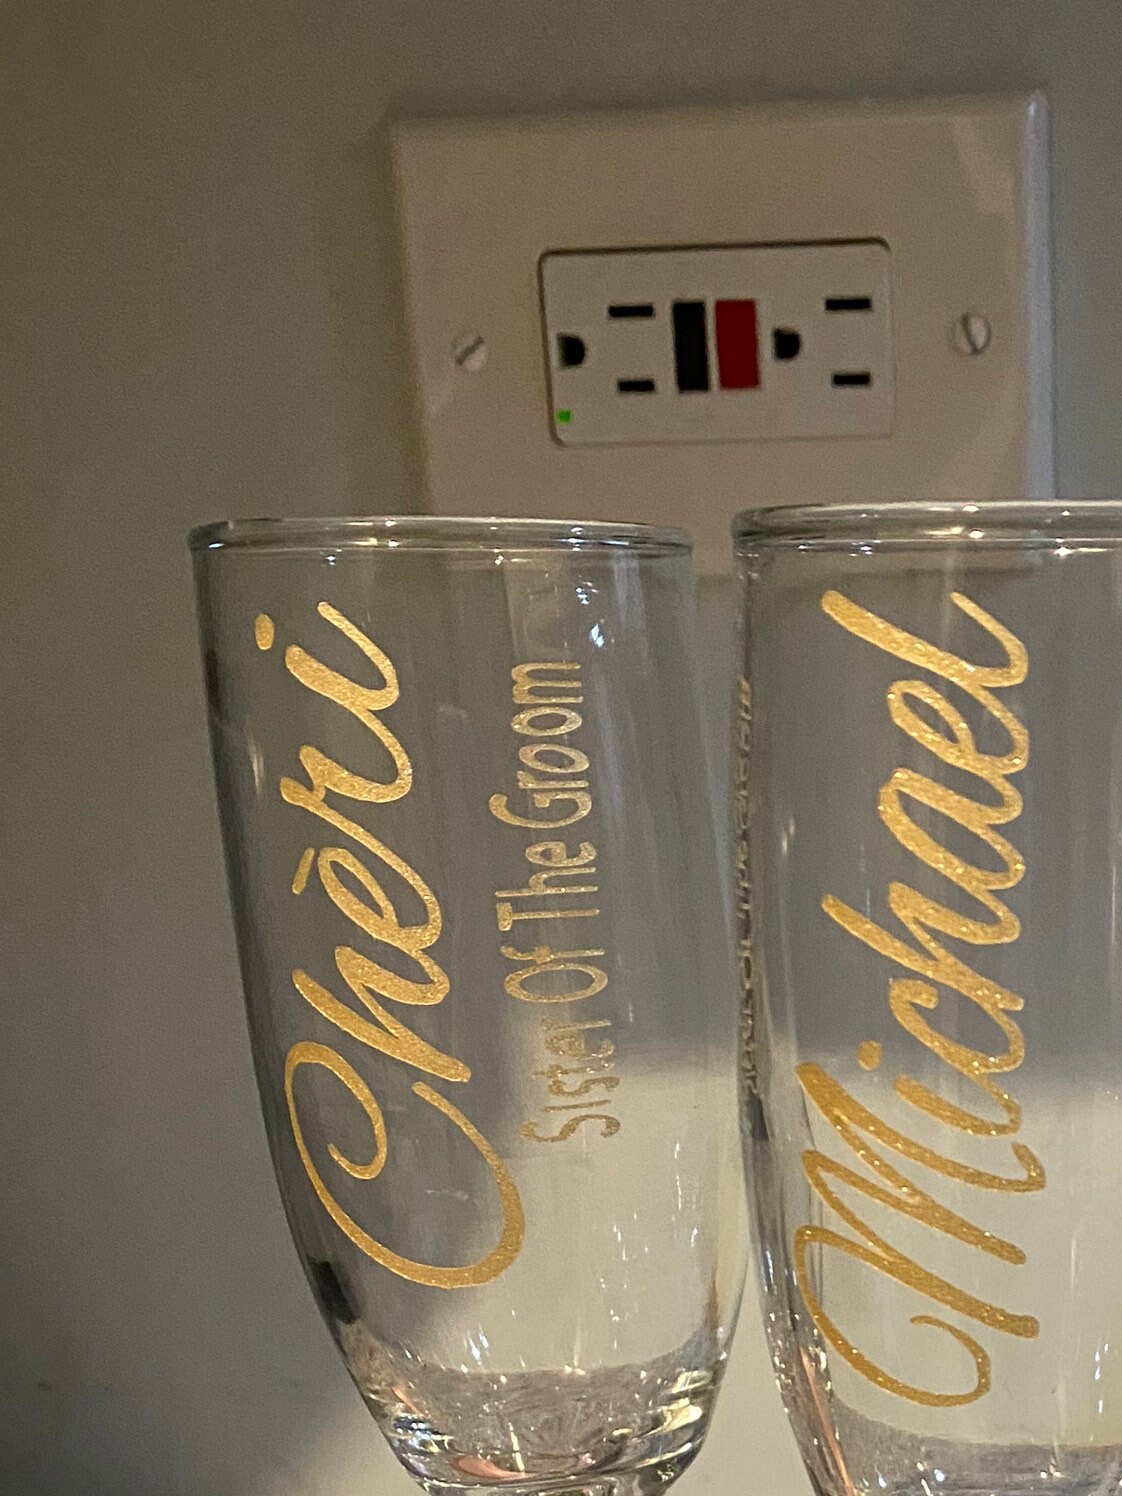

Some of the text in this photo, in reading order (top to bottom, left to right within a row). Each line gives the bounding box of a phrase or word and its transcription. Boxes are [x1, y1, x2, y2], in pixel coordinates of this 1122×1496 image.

[489, 661, 621, 1144] Sister Of The Groom
[795, 589, 1046, 1408] Michael
